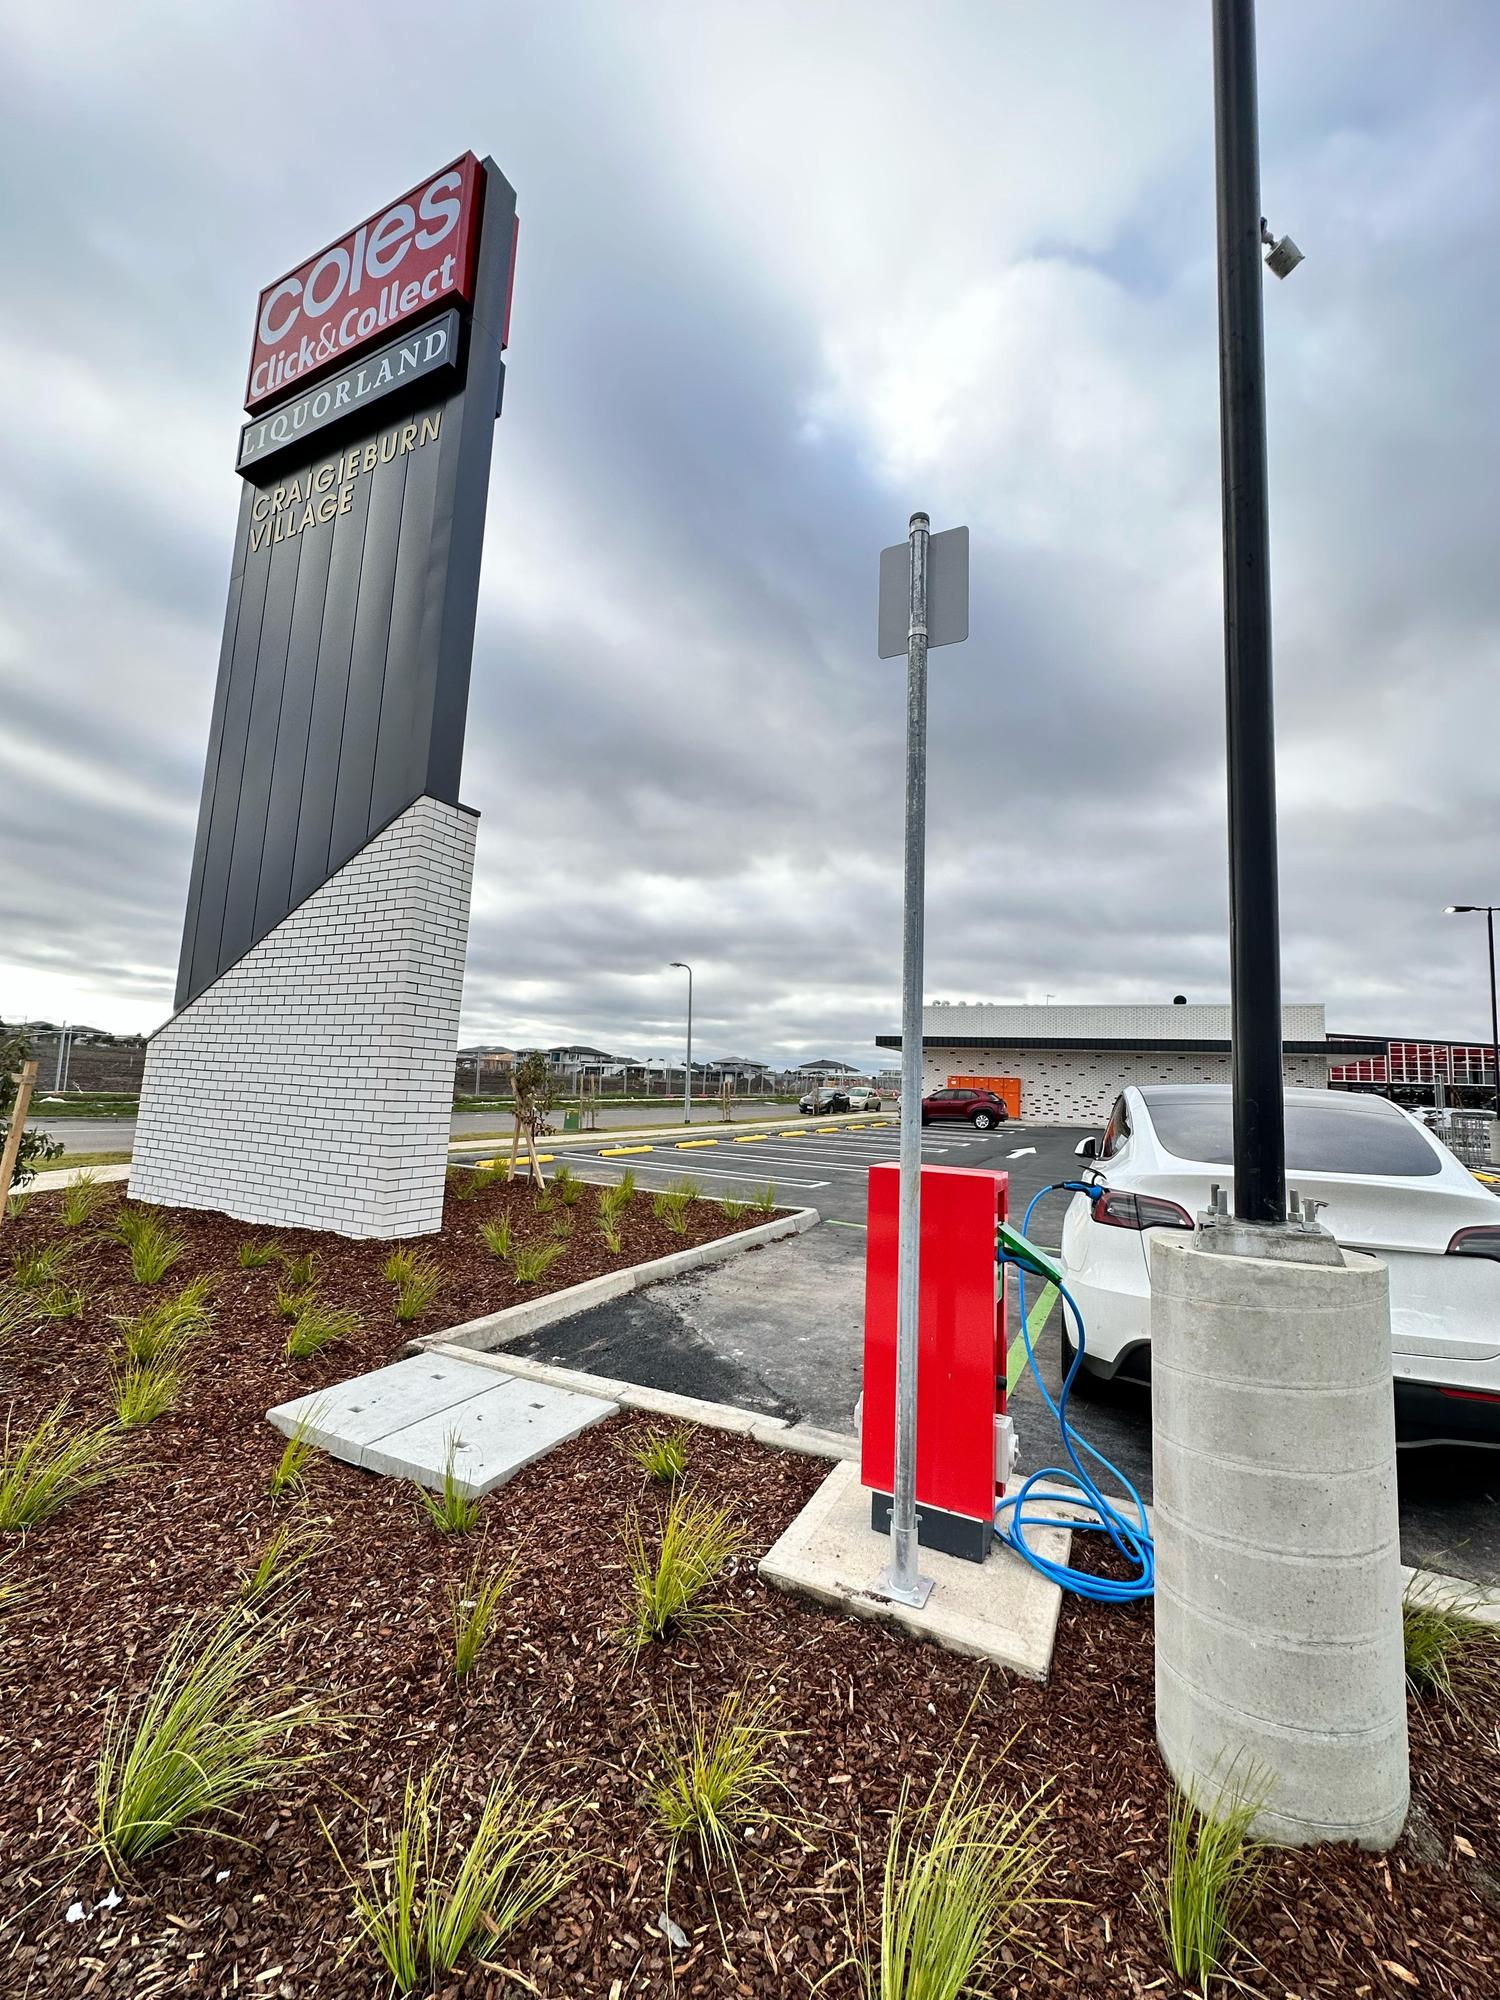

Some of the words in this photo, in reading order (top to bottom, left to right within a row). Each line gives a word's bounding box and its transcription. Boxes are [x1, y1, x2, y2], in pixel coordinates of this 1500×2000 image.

[259, 171, 462, 346] coles
[250, 254, 456, 398] Click&Collect
[241, 330, 447, 458] LIQUORLAND
[250, 484, 354, 552] VILLAGE
[253, 412, 443, 522] CRAIGIEBURN
